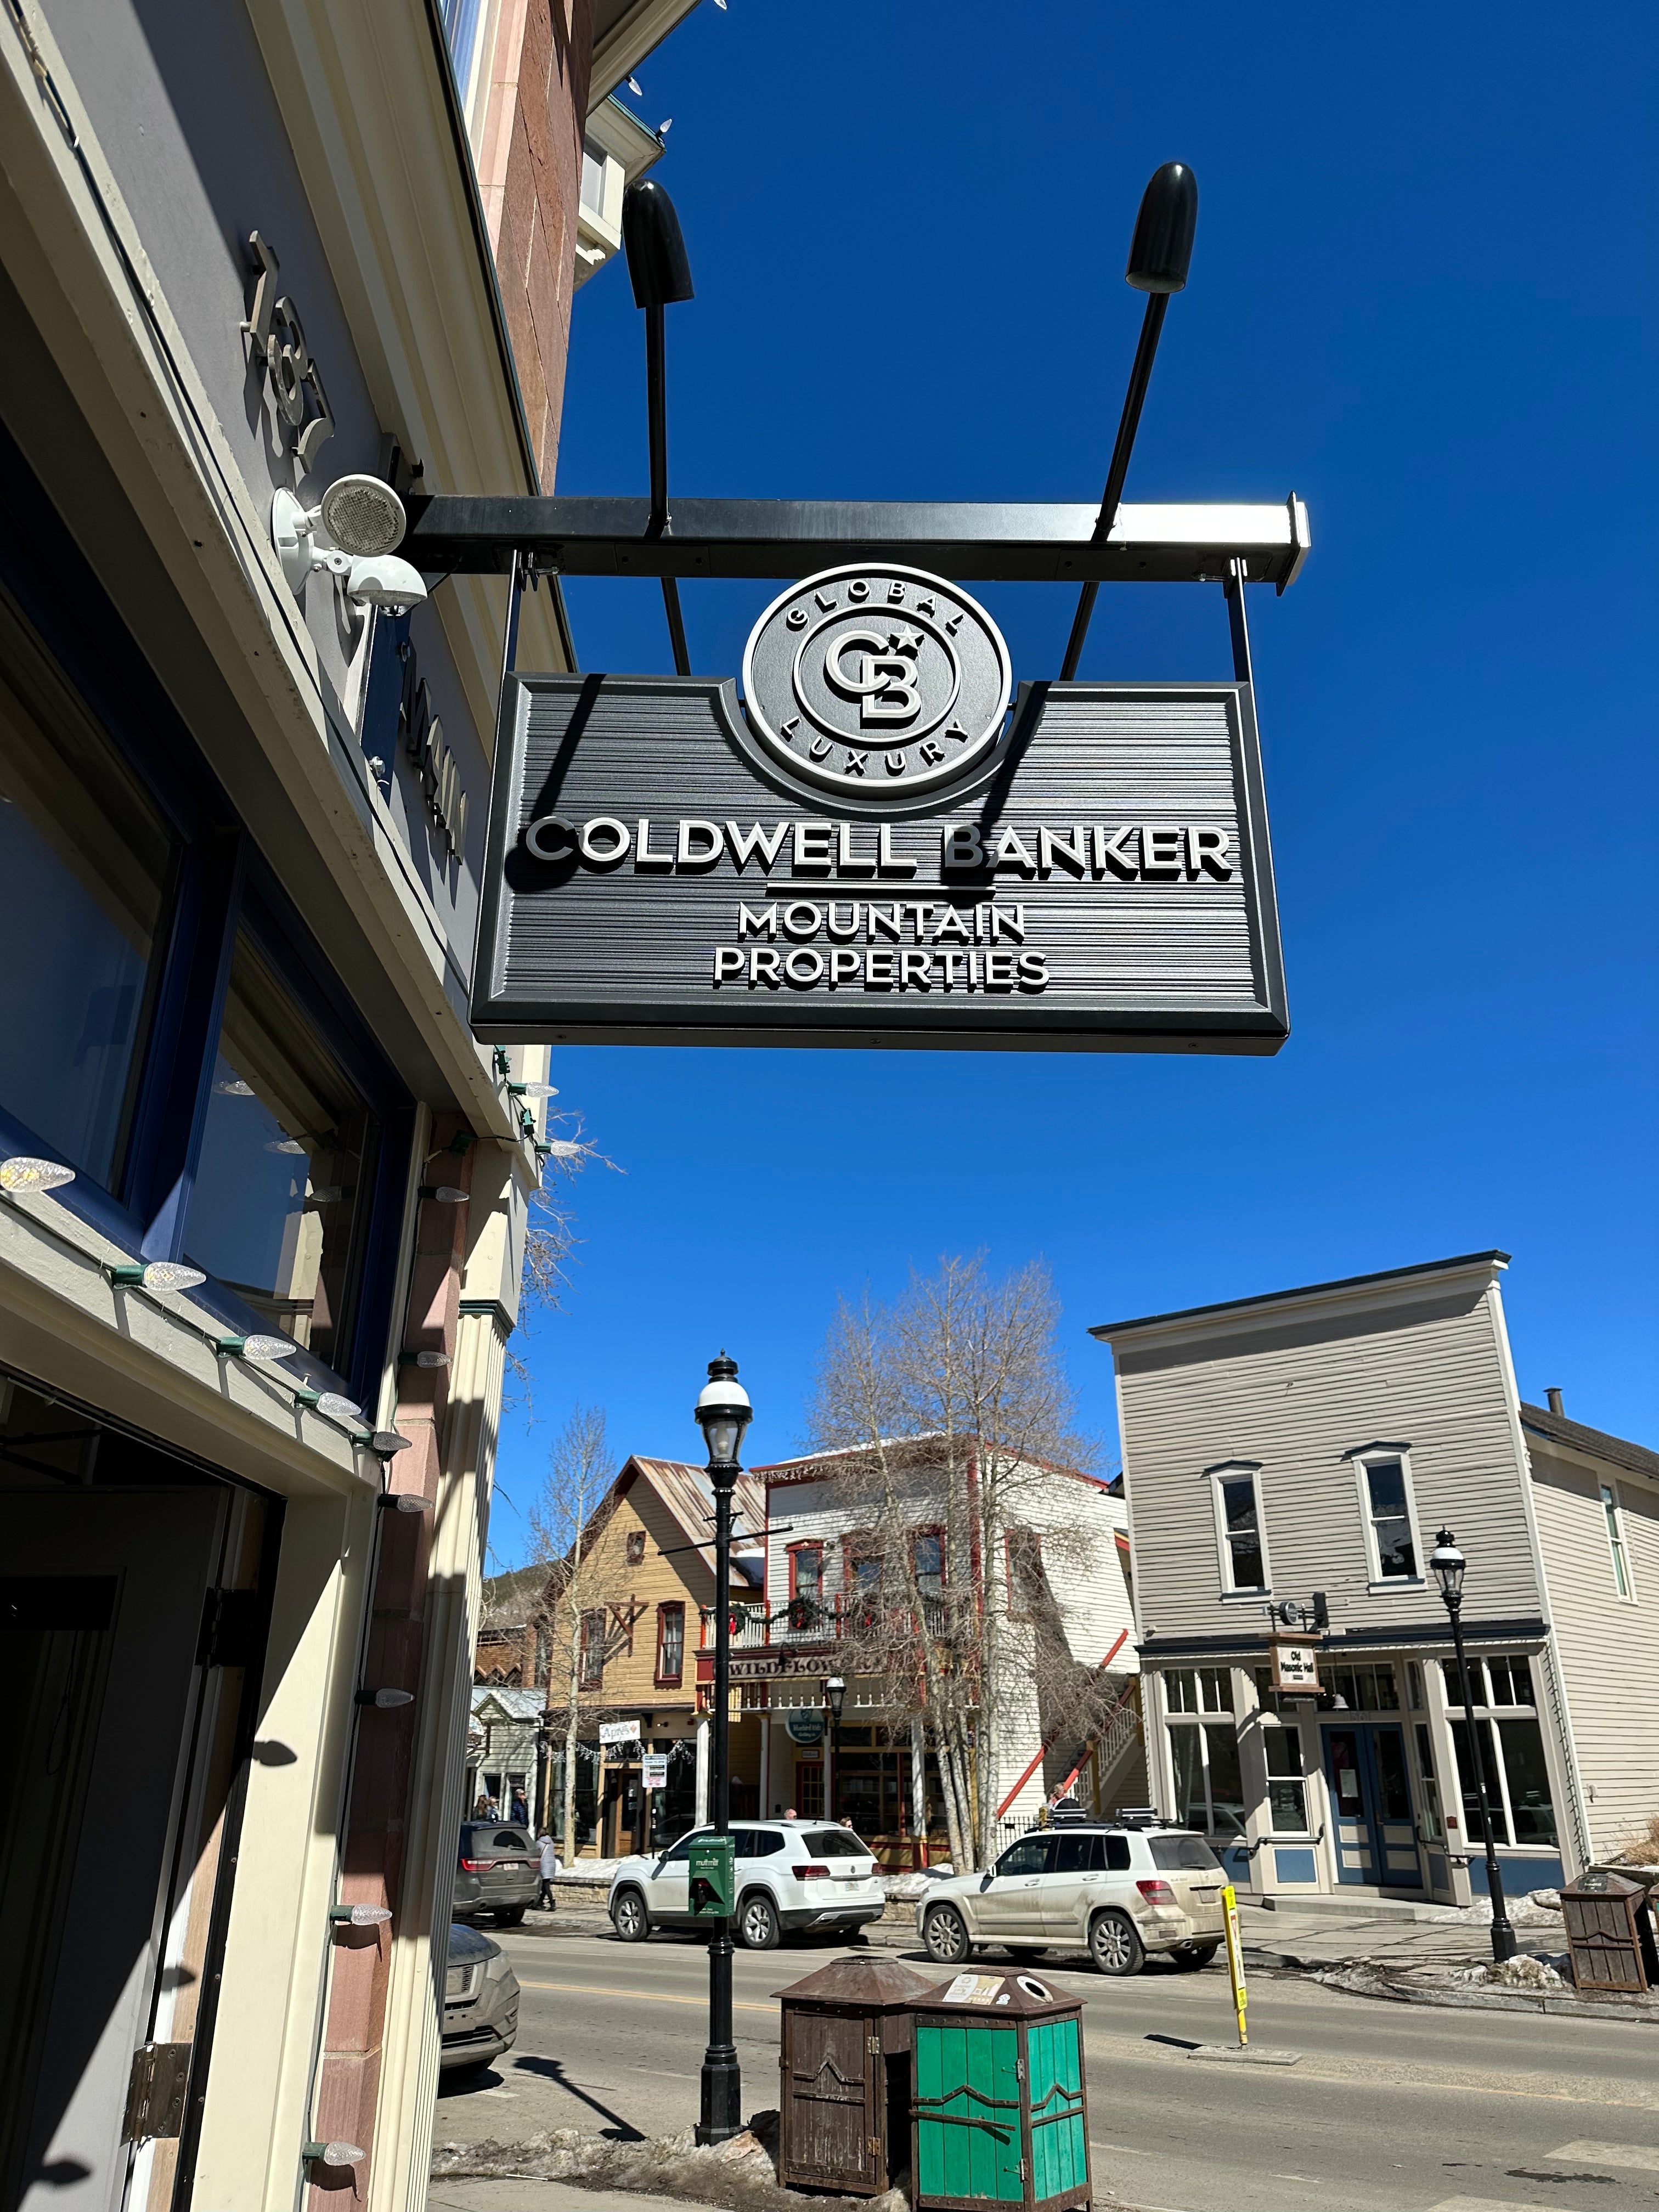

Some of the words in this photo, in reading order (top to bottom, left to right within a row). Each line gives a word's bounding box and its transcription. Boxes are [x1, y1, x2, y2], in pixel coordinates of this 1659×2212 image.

[249, 229, 336, 474] 137
[402, 636, 470, 866] MAIN
[787, 579, 964, 631] GLOBAL
[825, 629, 921, 718] CB
[782, 715, 968, 770] LUXURY
[526, 815, 918, 868] COLDWELL
[943, 824, 1234, 870] BANKER
[739, 901, 1026, 938] MOUNTAIN
[715, 946, 1050, 986] PROPERTIES
[1280, 1661, 1302, 1673] Masonic
[1303, 1662, 1314, 1673] Hall
[1291, 1651, 1301, 1661] Old
